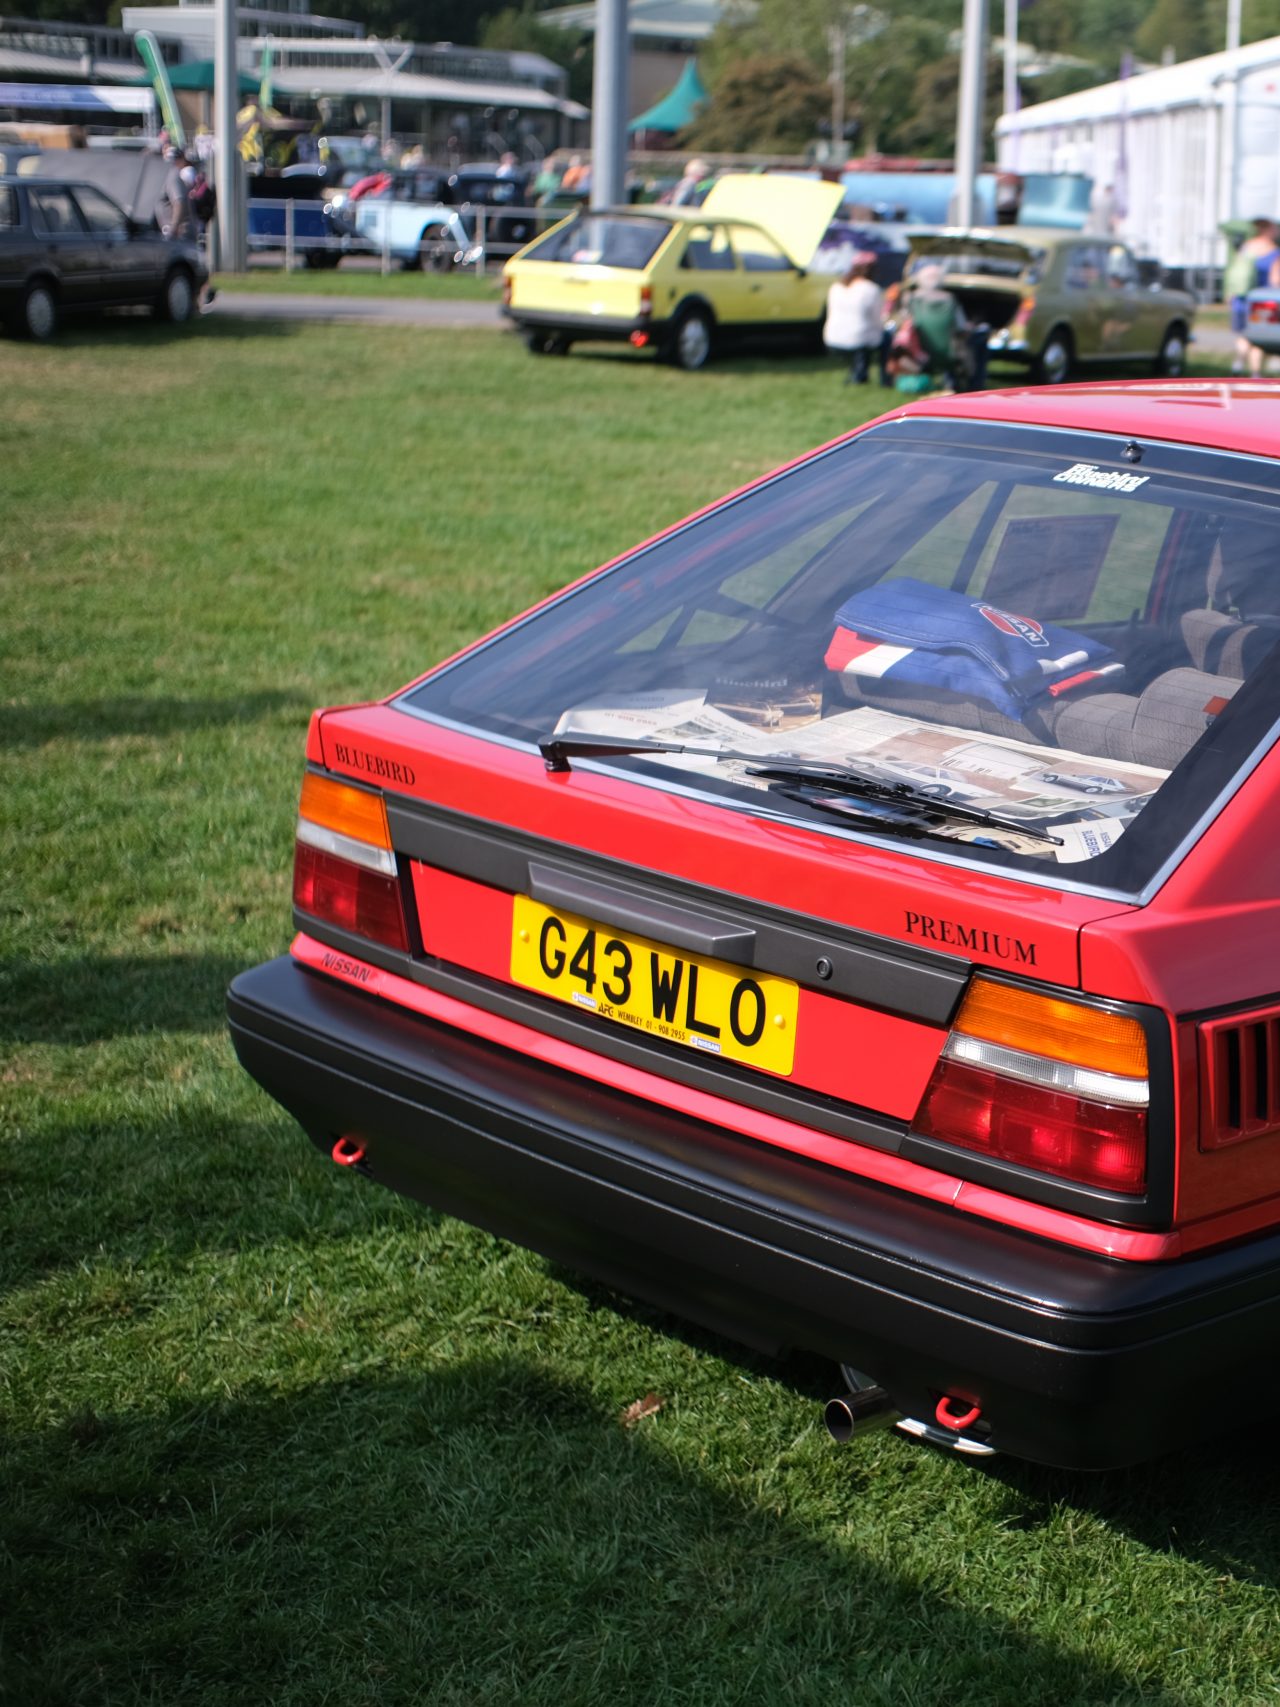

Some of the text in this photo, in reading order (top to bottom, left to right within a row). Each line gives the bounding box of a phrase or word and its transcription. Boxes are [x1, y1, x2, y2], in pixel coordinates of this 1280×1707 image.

[335, 743, 415, 786] BLUEBIRD
[904, 910, 1038, 966] PREMIUM
[321, 953, 371, 983] NISSAN
[540, 916, 766, 1047] G43 WLO
[617, 1010, 642, 1027] WEMBLEY
[658, 1025, 669, 1036] 908
[671, 1028, 686, 1041] 2955
[697, 1038, 721, 1053] NISSAN
